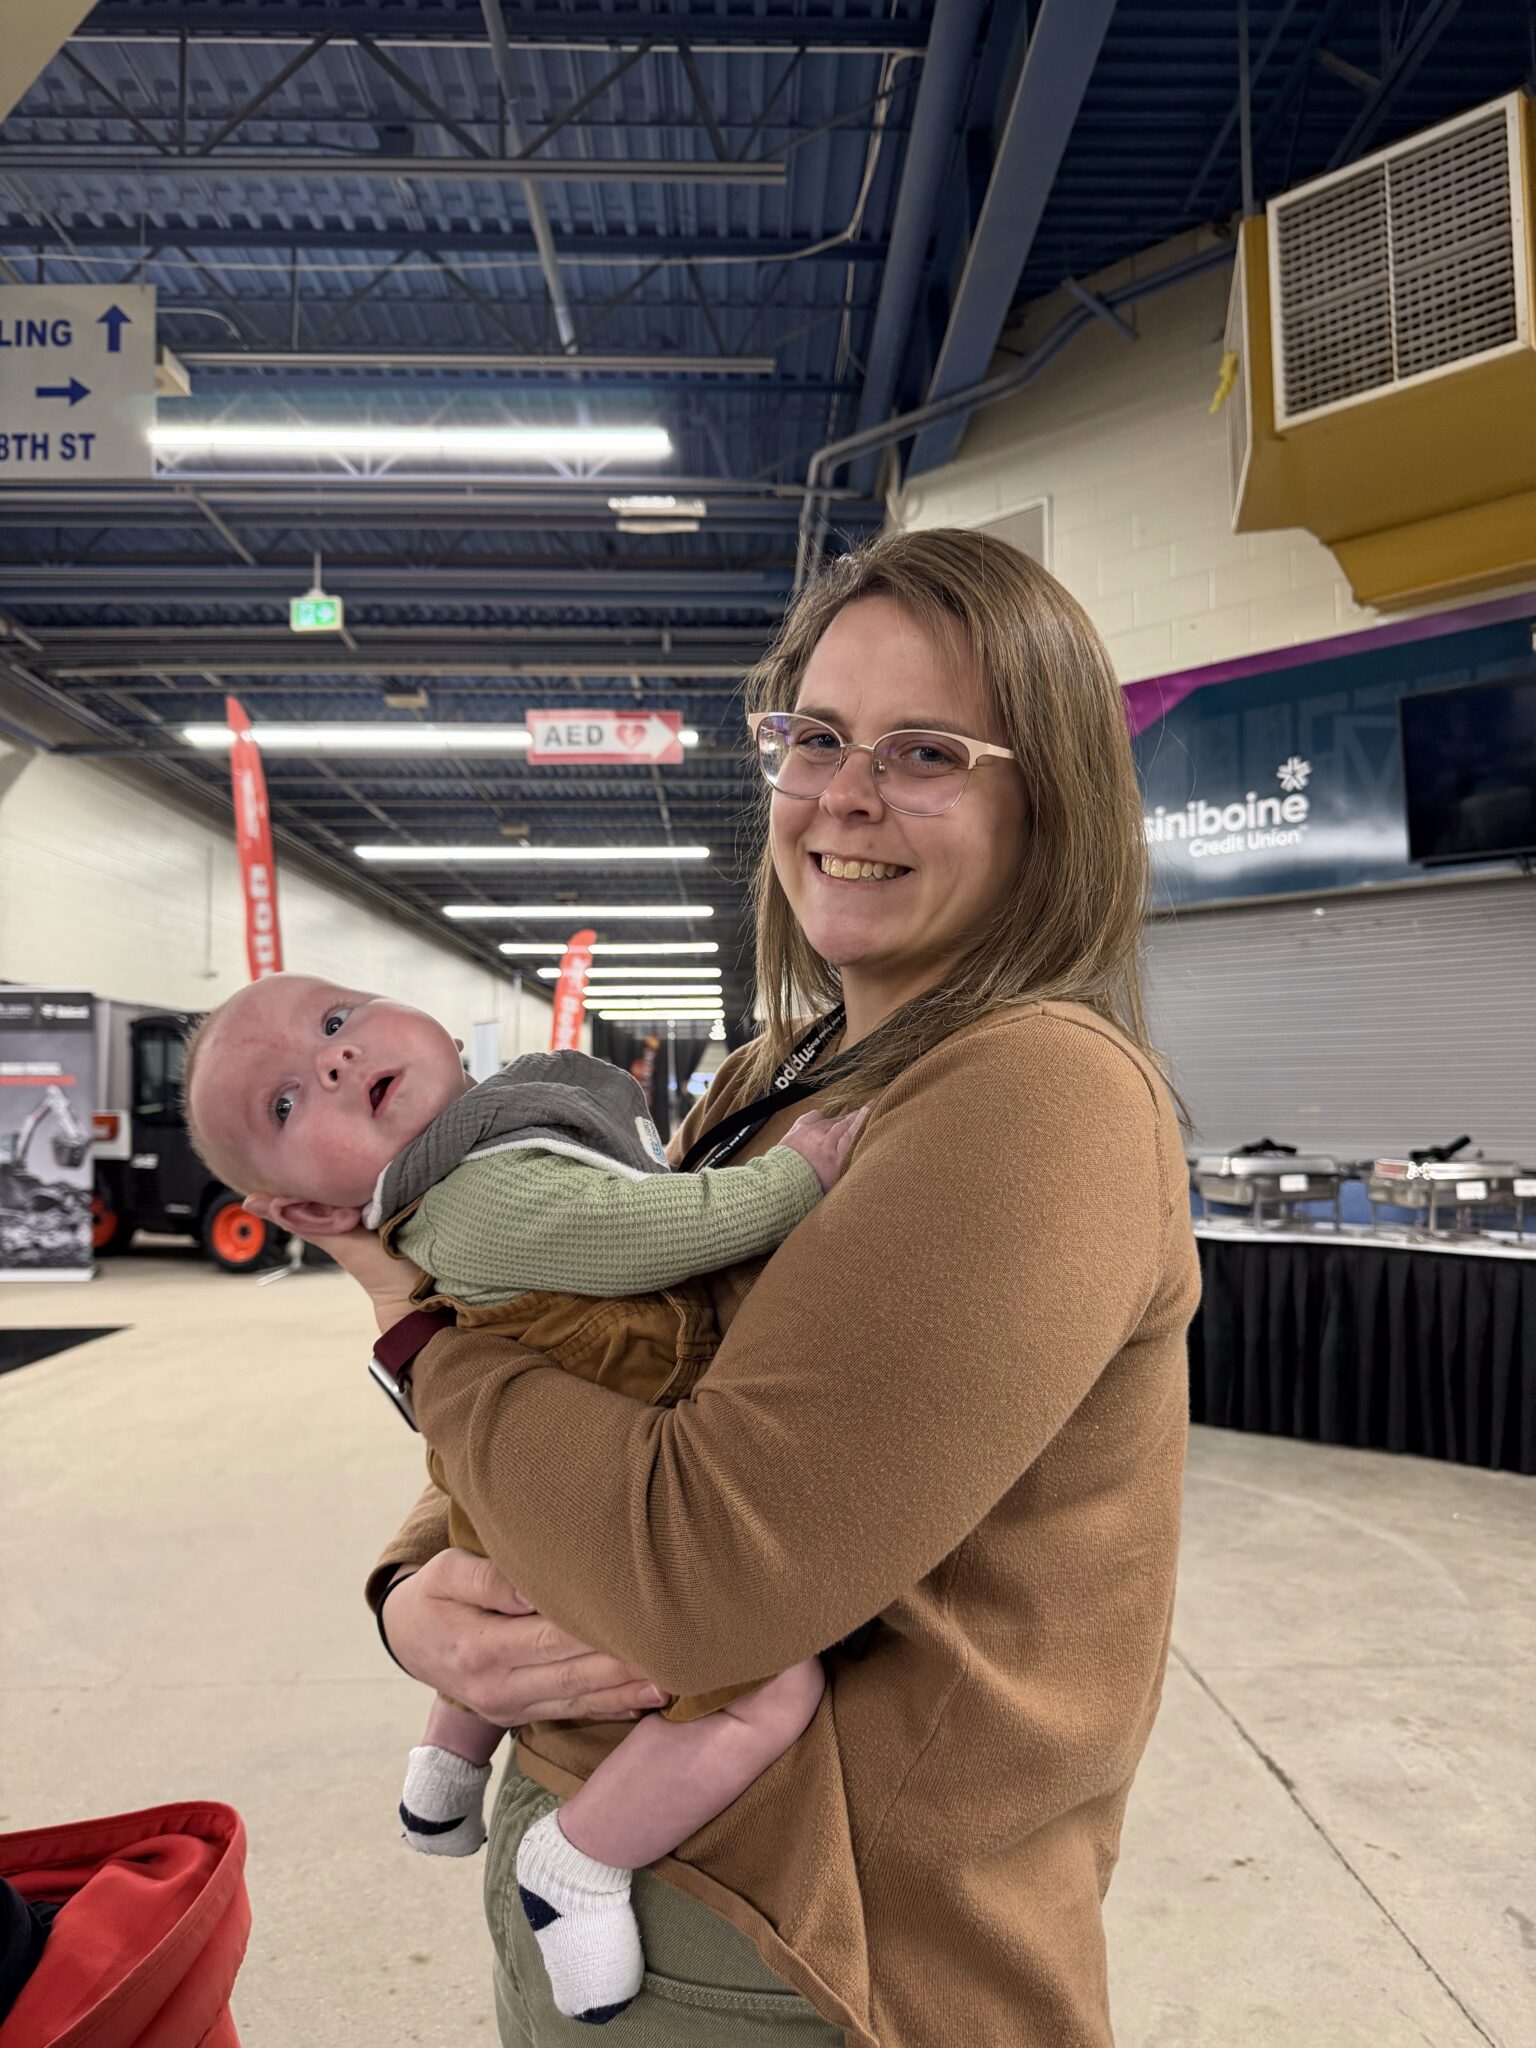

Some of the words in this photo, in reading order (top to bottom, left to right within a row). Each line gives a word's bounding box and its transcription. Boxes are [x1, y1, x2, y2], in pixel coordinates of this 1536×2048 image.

[0, 319, 72, 347] LING
[60, 432, 96, 461] ST
[543, 724, 604, 748] AED
[1188, 833, 1245, 858] Credit
[1246, 827, 1302, 850] Union
